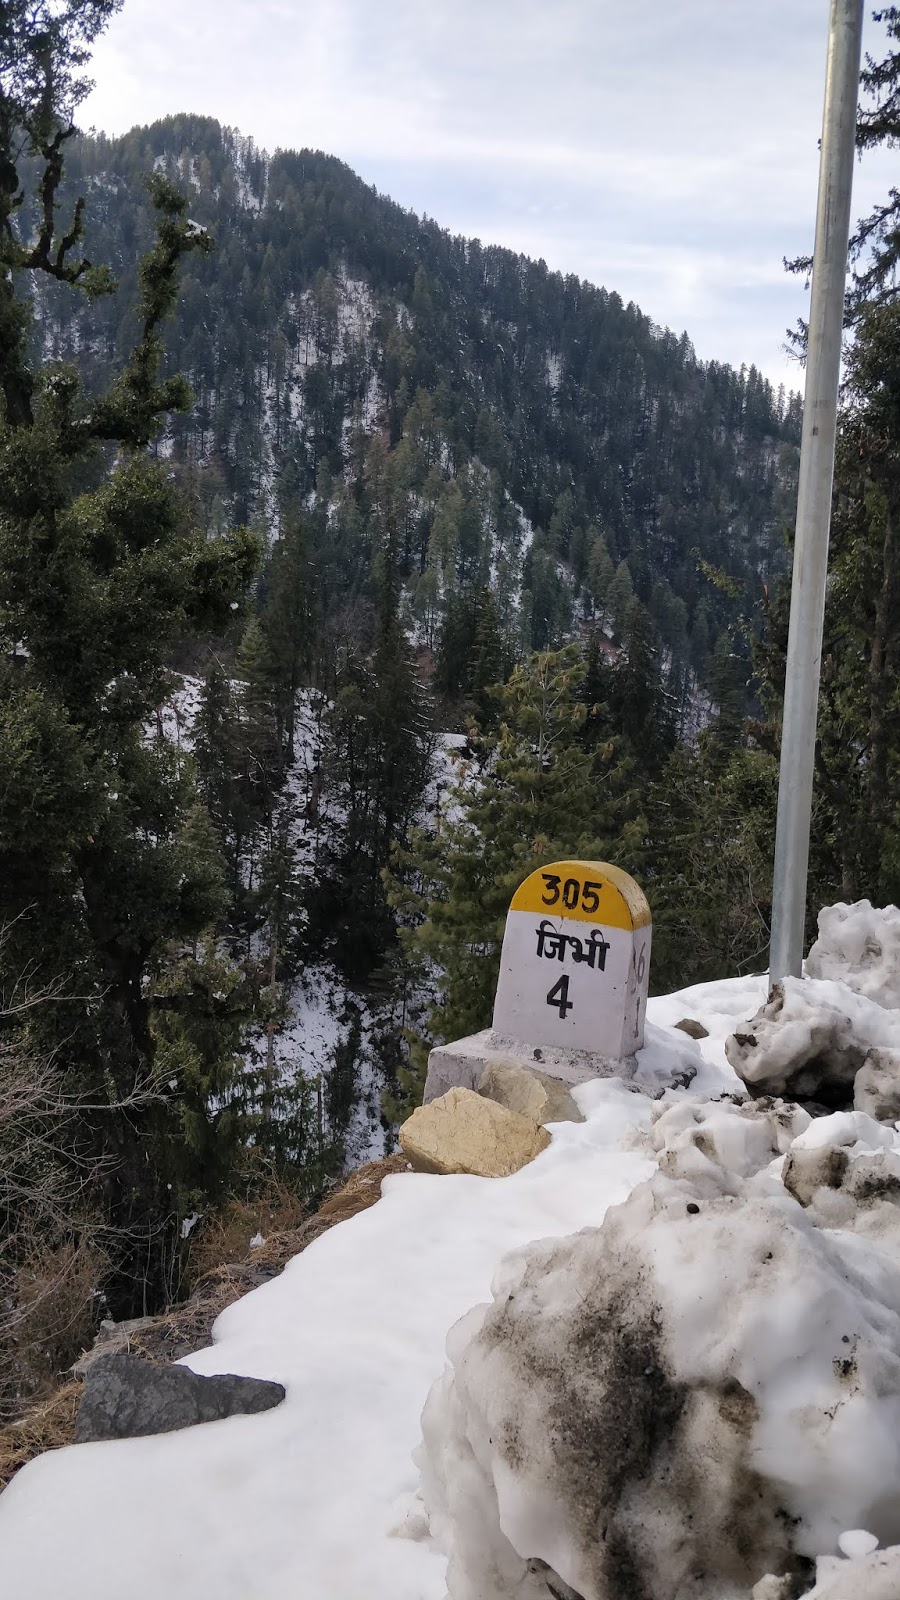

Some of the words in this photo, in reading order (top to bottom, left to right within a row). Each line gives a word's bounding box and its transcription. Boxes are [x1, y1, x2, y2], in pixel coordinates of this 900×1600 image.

[541, 873, 602, 914] 305
[535, 919, 611, 972] जिभी
[546, 974, 573, 1020] 4
